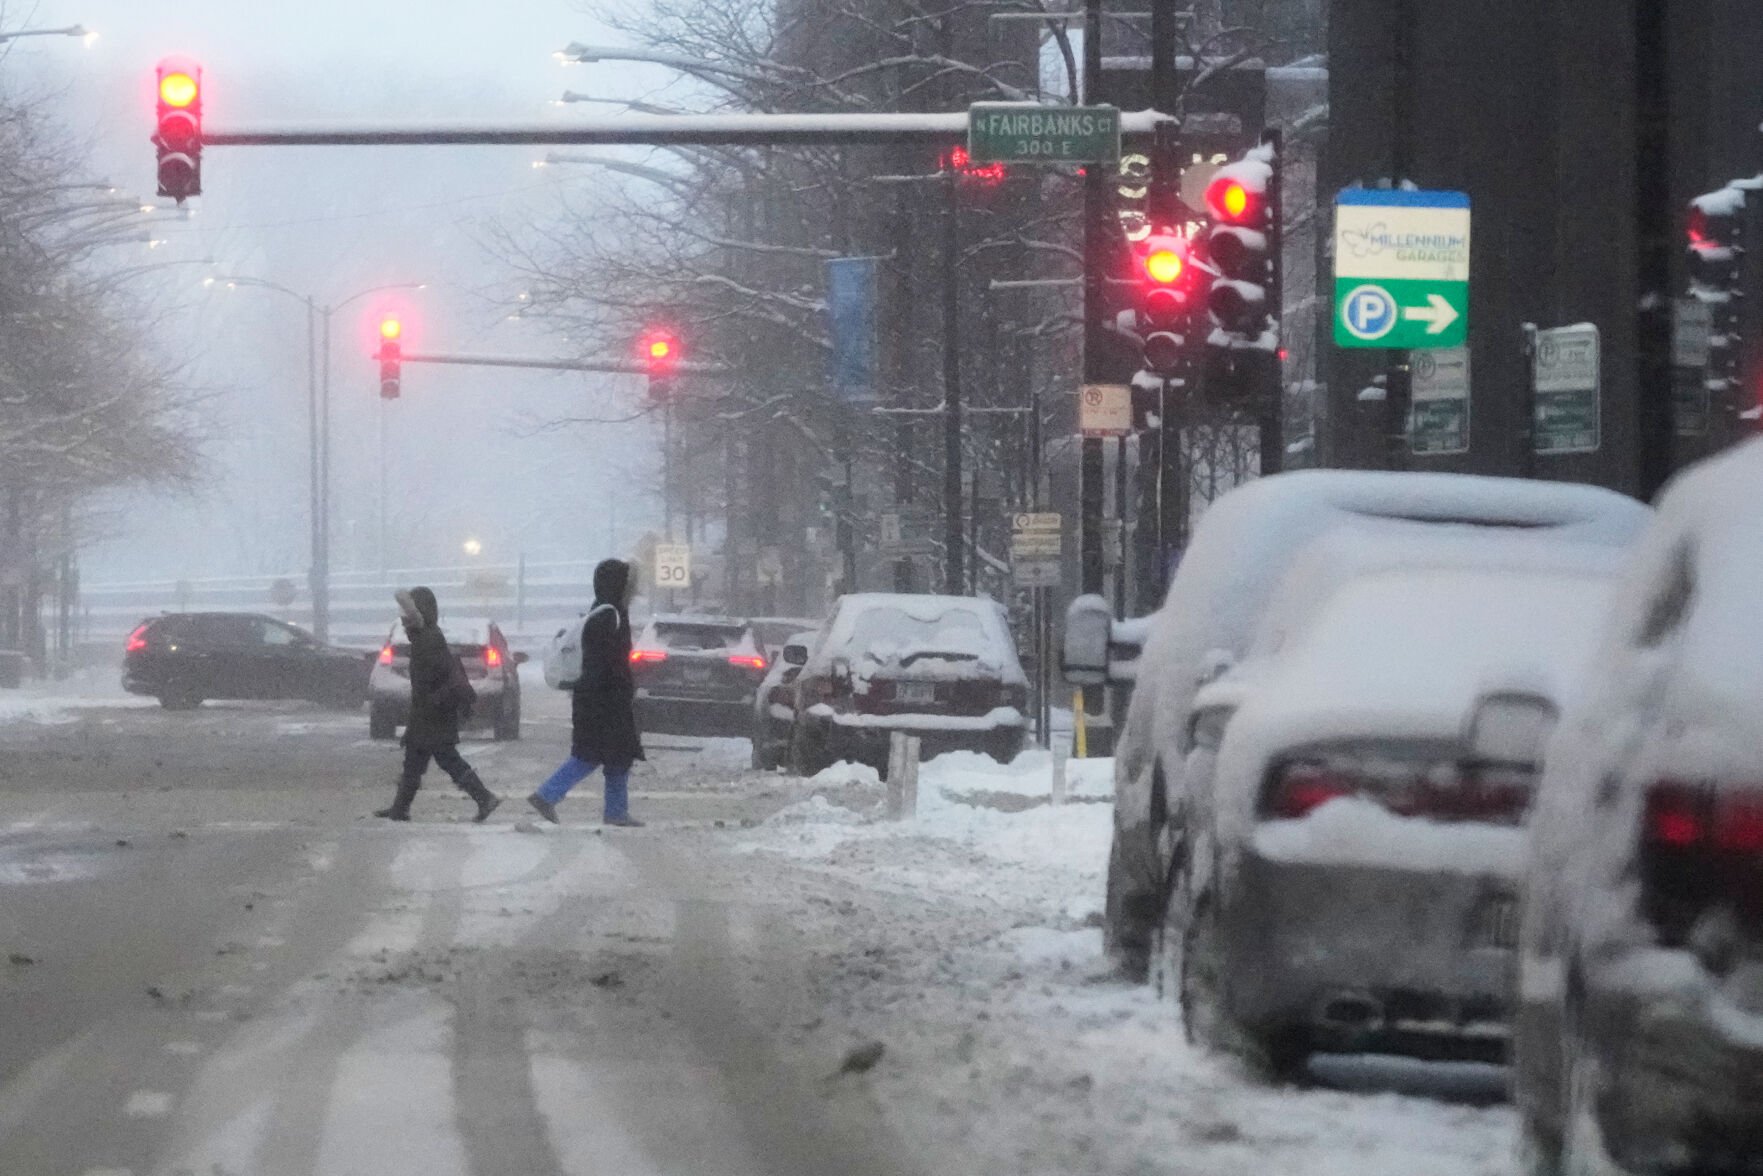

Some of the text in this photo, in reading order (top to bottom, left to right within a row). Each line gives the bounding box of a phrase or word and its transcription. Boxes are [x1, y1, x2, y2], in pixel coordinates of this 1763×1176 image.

[976, 114, 1112, 136] N FAIRBANKS CT
[1016, 140, 1072, 155] 300 E
[1370, 233, 1465, 249] MILLENNIUM
[1396, 250, 1466, 263] GARAGES
[1358, 293, 1386, 330] P
[660, 565, 685, 580] 30
